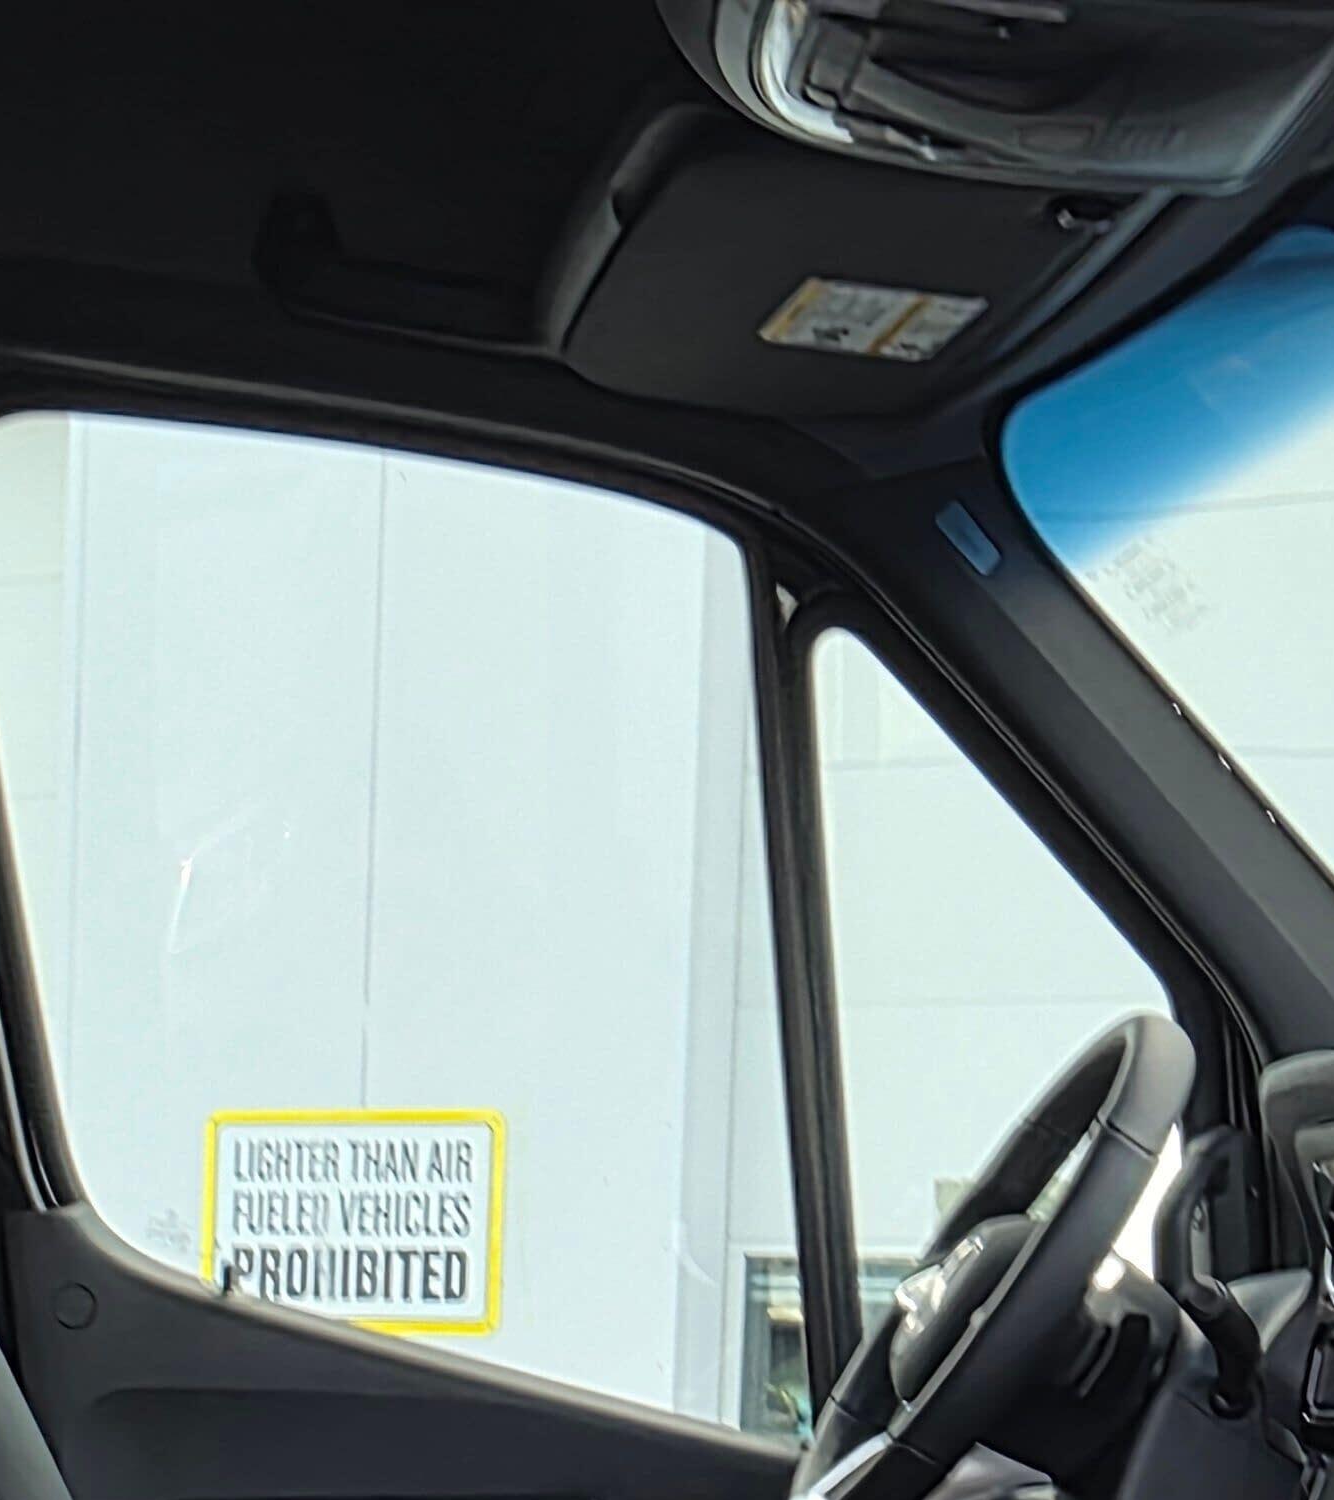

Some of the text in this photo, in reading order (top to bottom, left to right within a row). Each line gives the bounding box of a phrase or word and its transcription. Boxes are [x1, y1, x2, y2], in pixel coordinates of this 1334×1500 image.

[233, 1139, 473, 1183] LIGHTER THAN AIR
[232, 1190, 472, 1238] FUELED VEHICLES
[231, 1247, 467, 1302] PROHIBITED
